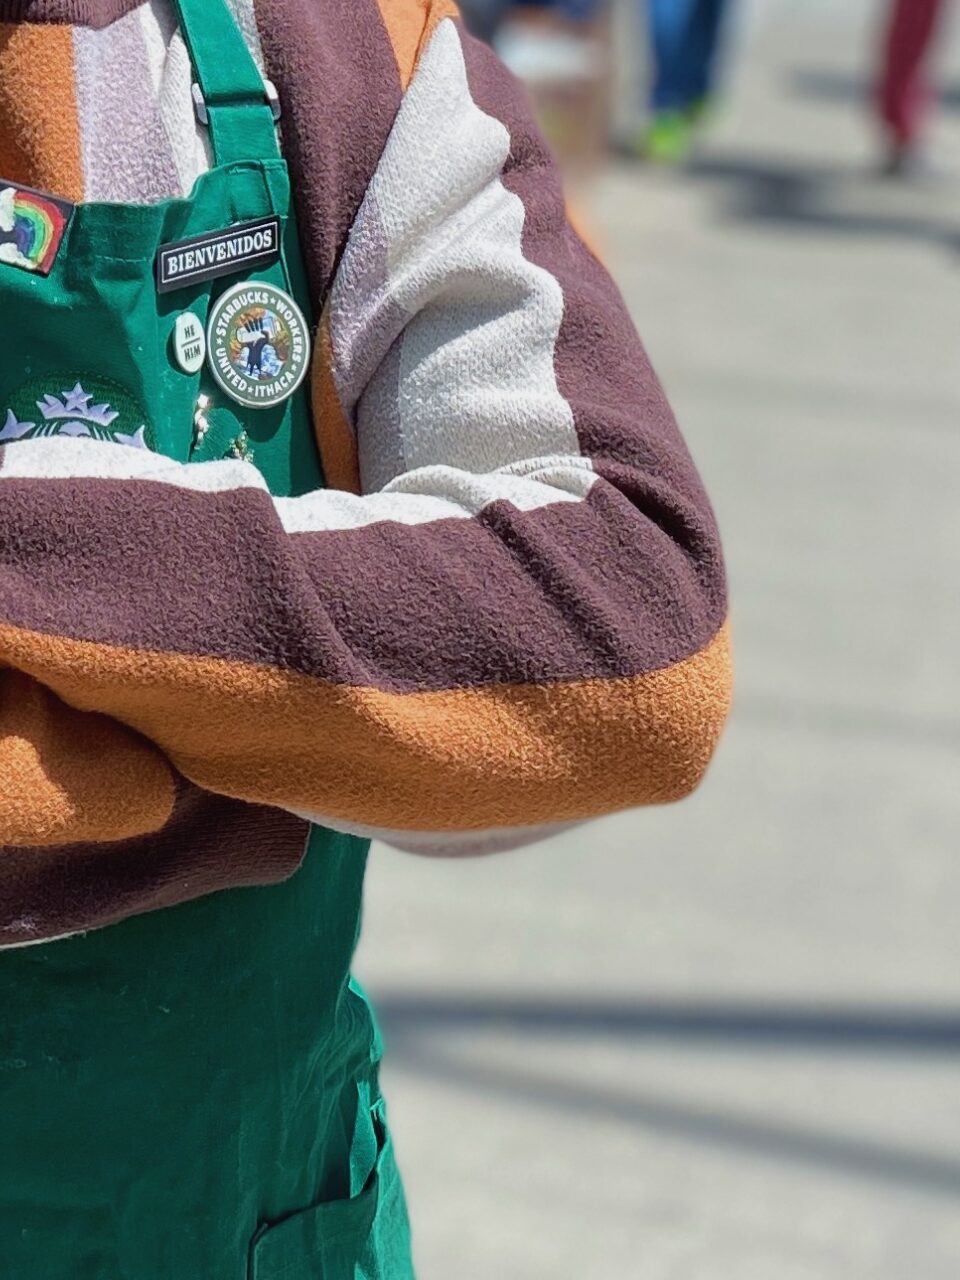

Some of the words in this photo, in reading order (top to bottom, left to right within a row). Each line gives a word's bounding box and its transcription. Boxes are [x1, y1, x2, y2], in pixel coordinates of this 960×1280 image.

[167, 229, 273, 275] BIENVENIDOS
[184, 325, 195, 338] HE
[216, 291, 269, 336] STARBUCKS
[276, 301, 303, 366] WORKERS
[184, 346, 201, 362] HIM
[215, 348, 246, 392] UNITED
[254, 371, 295, 397] ITHACA
